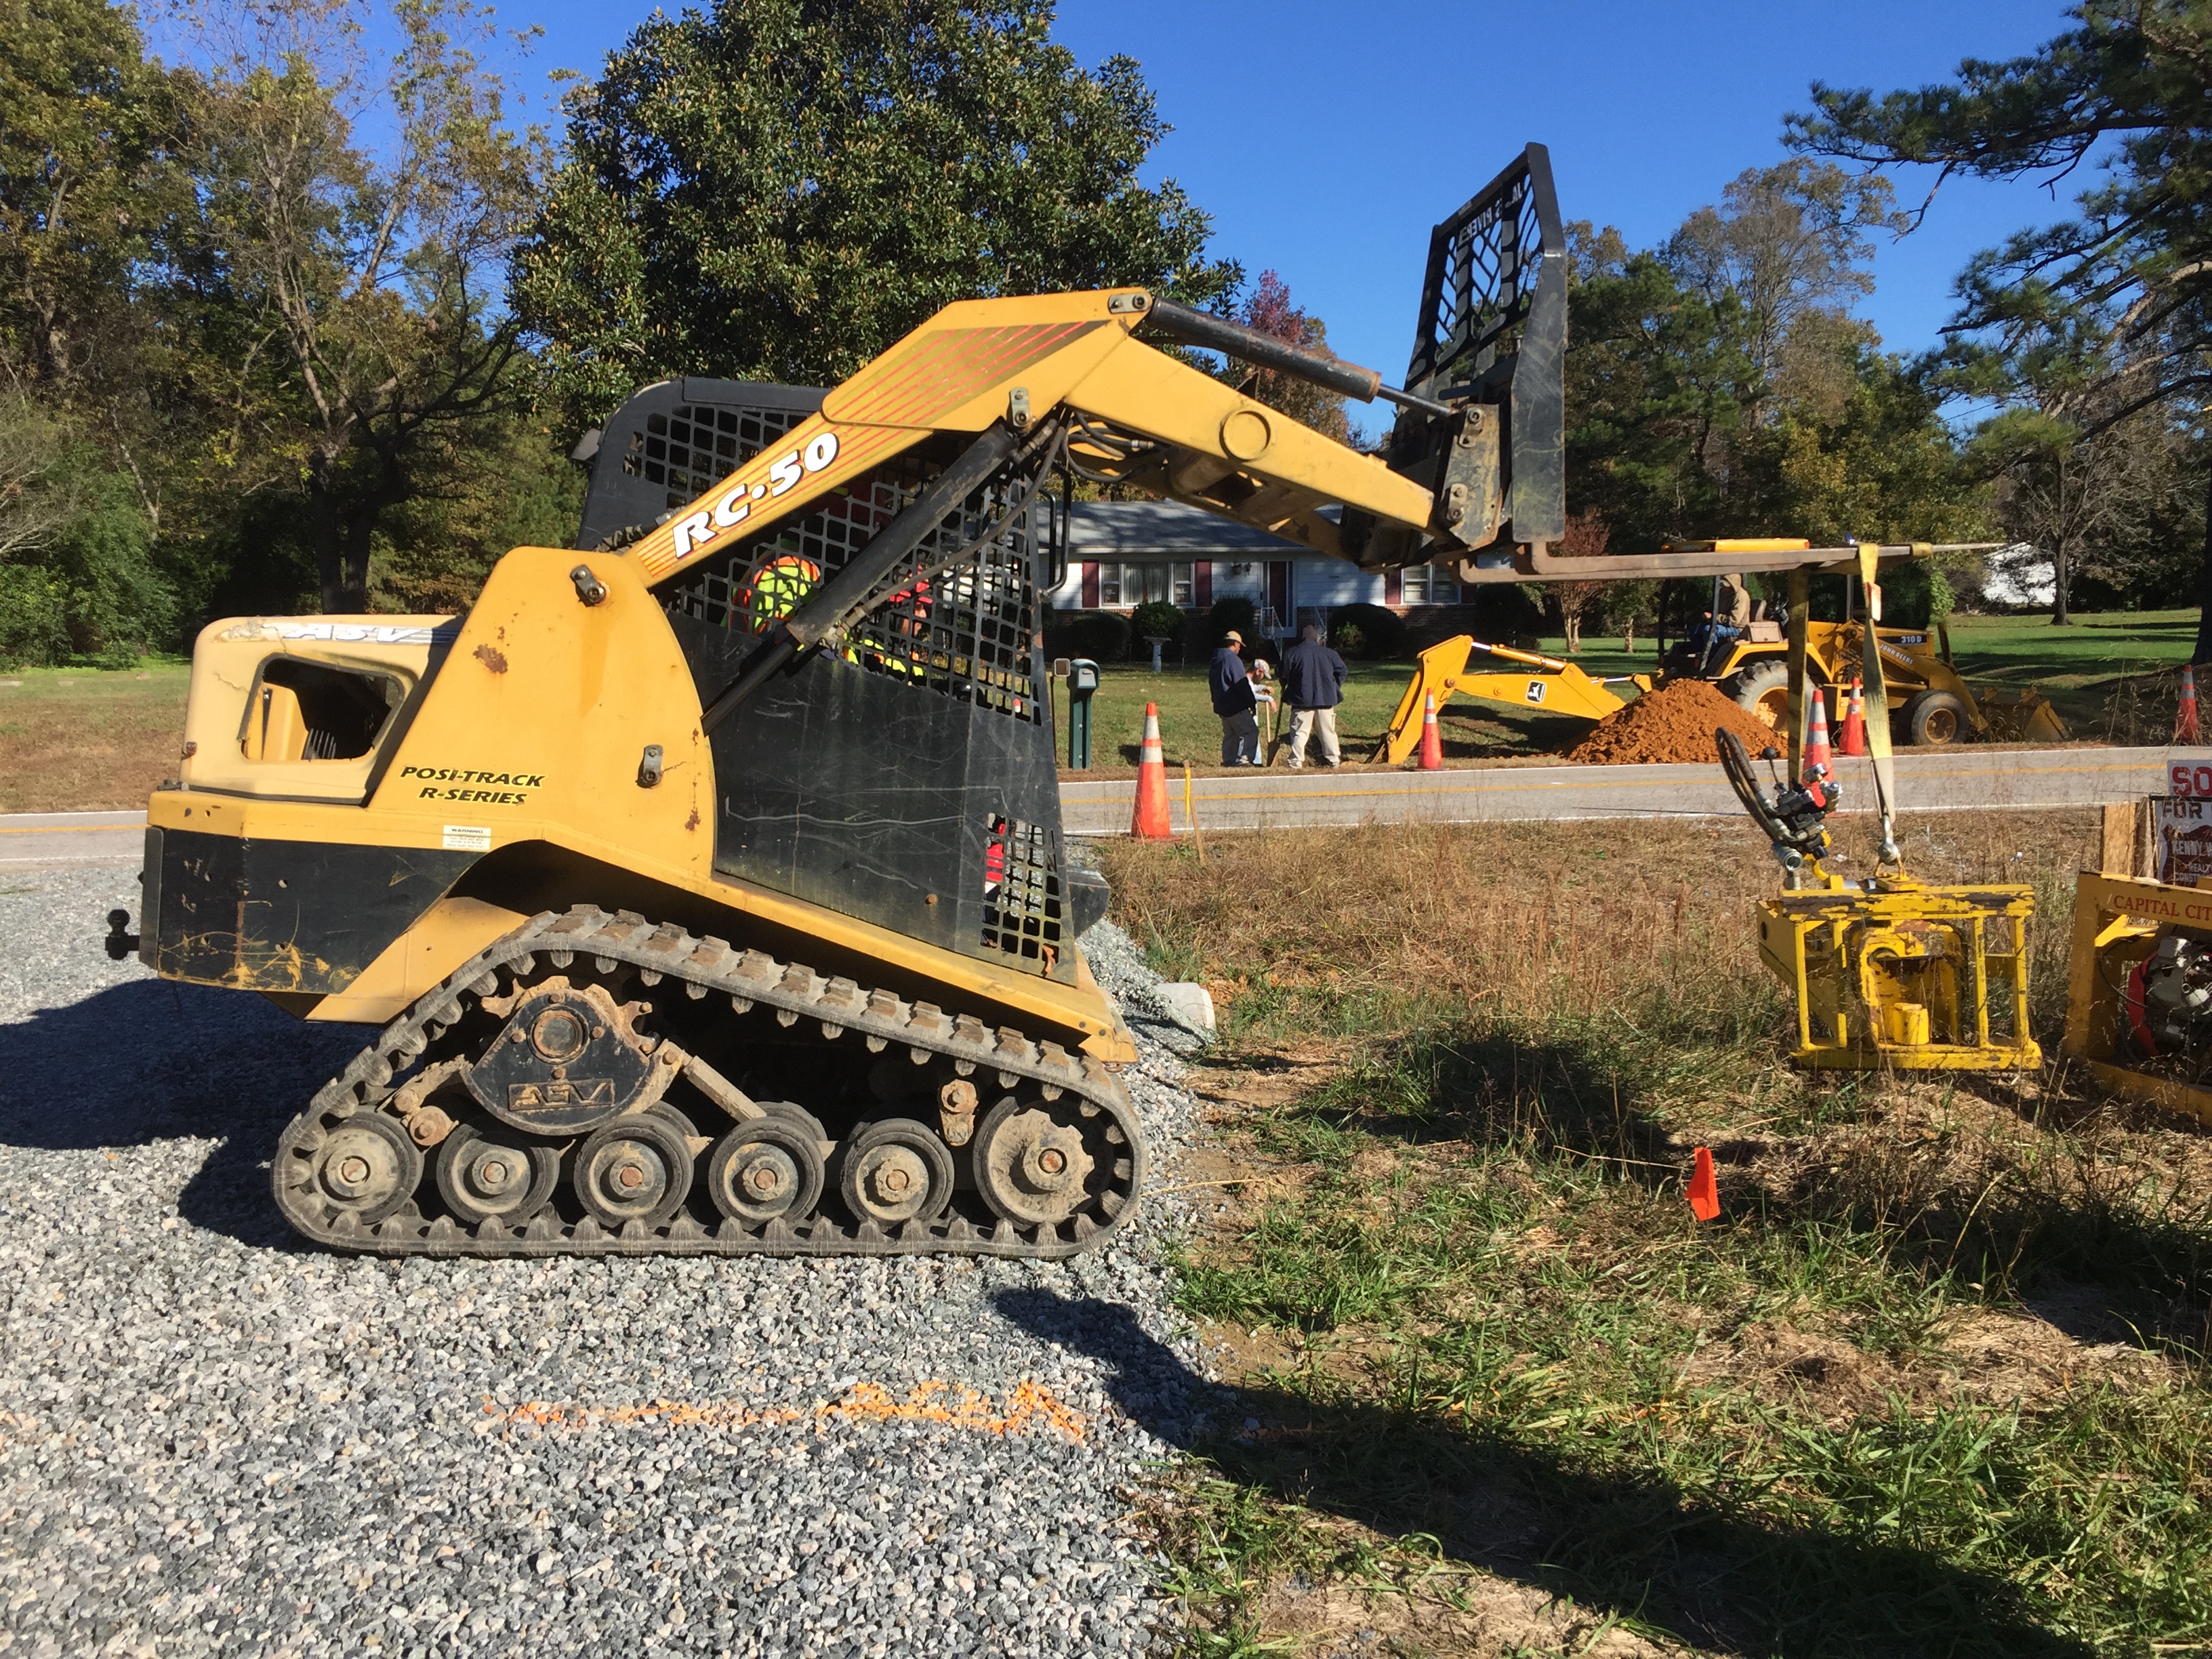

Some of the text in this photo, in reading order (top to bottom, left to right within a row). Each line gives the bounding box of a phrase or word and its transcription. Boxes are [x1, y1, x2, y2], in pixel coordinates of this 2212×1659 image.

[283, 624, 421, 642] ASV
[1879, 644, 1914, 664] JOHN DEERE
[400, 766, 546, 787] POSI-TRACK
[418, 787, 528, 805] R-SERIES
[2161, 801, 2203, 819] FOR
[2113, 895, 2180, 918] CAPITAL
